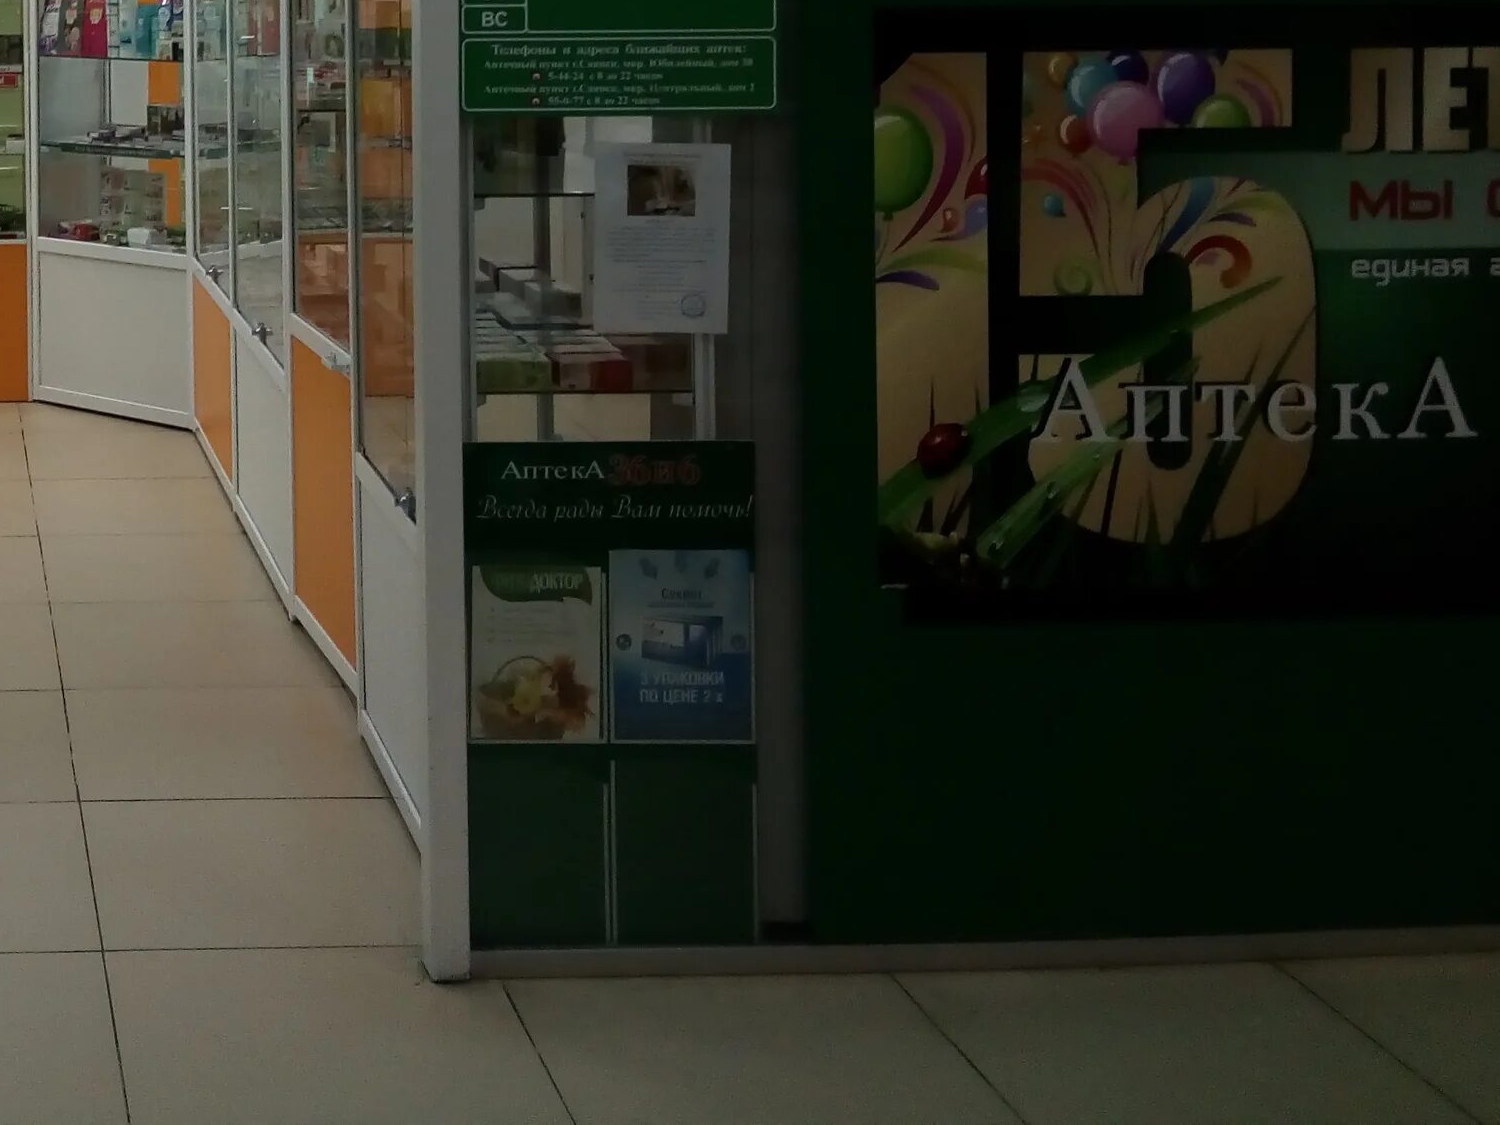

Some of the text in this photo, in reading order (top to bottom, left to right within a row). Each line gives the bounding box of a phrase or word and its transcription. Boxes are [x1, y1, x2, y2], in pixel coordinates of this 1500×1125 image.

[481, 11, 509, 27] ВС
[1349, 179, 1454, 221] МЫ
[1350, 256, 1470, 286] единая
[1030, 355, 1480, 444] АптекА
[475, 493, 754, 523] Всегда рады Вам помочь!
